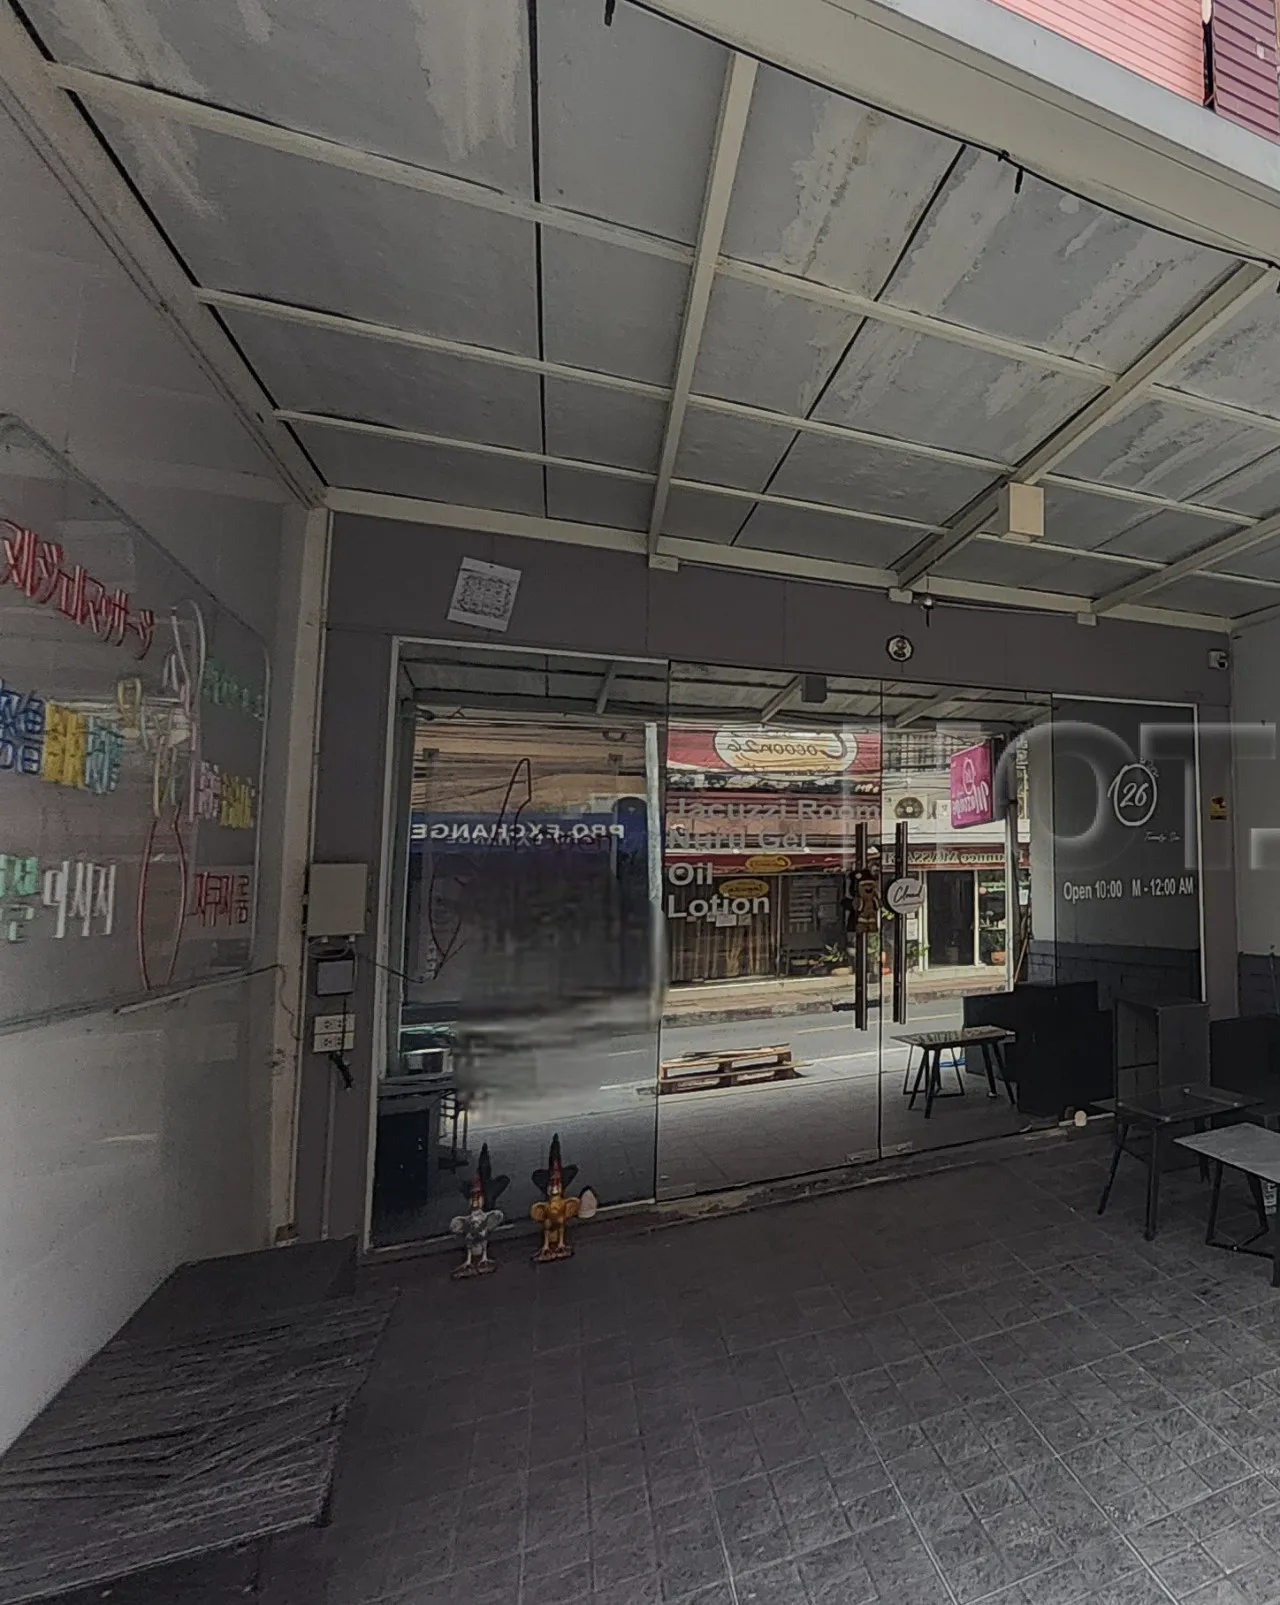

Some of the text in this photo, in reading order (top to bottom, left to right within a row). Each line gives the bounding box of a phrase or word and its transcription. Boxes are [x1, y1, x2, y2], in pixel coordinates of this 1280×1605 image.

[1120, 783, 1148, 807] 26
[667, 798, 880, 820] Jacuzzi Room
[668, 862, 713, 886] Oil
[1063, 881, 1092, 904] Open
[1095, 880, 1123, 899] 10:00
[1179, 876, 1194, 895] AM
[668, 894, 770, 919] Lotion
